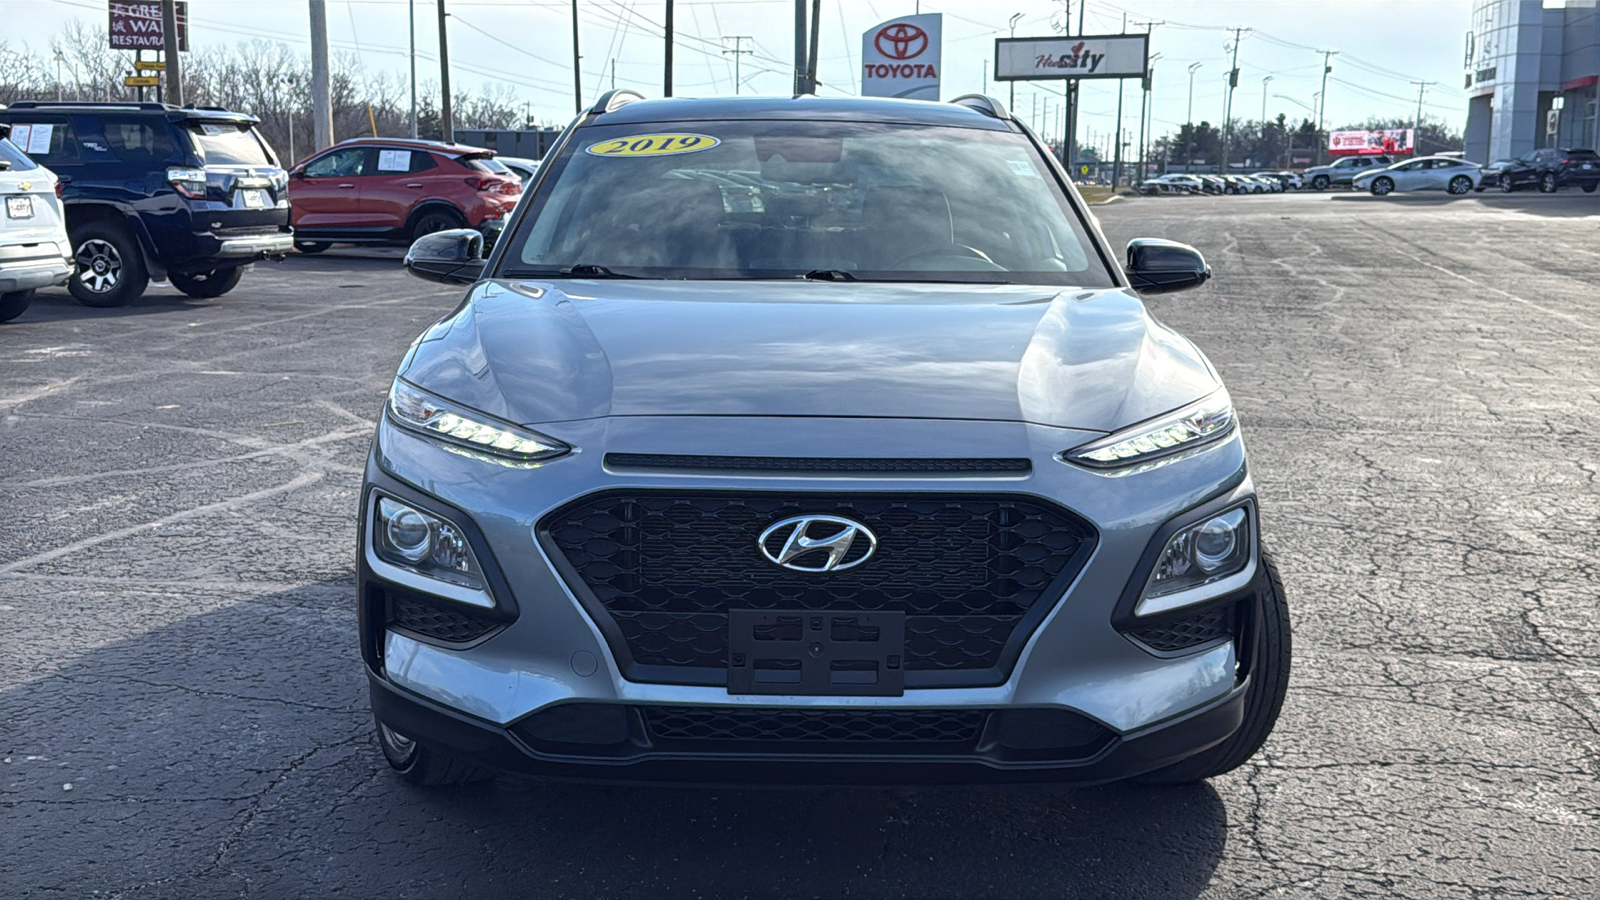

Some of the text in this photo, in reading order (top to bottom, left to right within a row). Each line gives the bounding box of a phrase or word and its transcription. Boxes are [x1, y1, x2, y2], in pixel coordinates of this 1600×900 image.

[128, 4, 180, 18] GRE
[129, 20, 164, 33] WA
[112, 35, 182, 46] RESTAURA
[864, 64, 937, 79] TOYOTA
[604, 137, 701, 154] 2019
